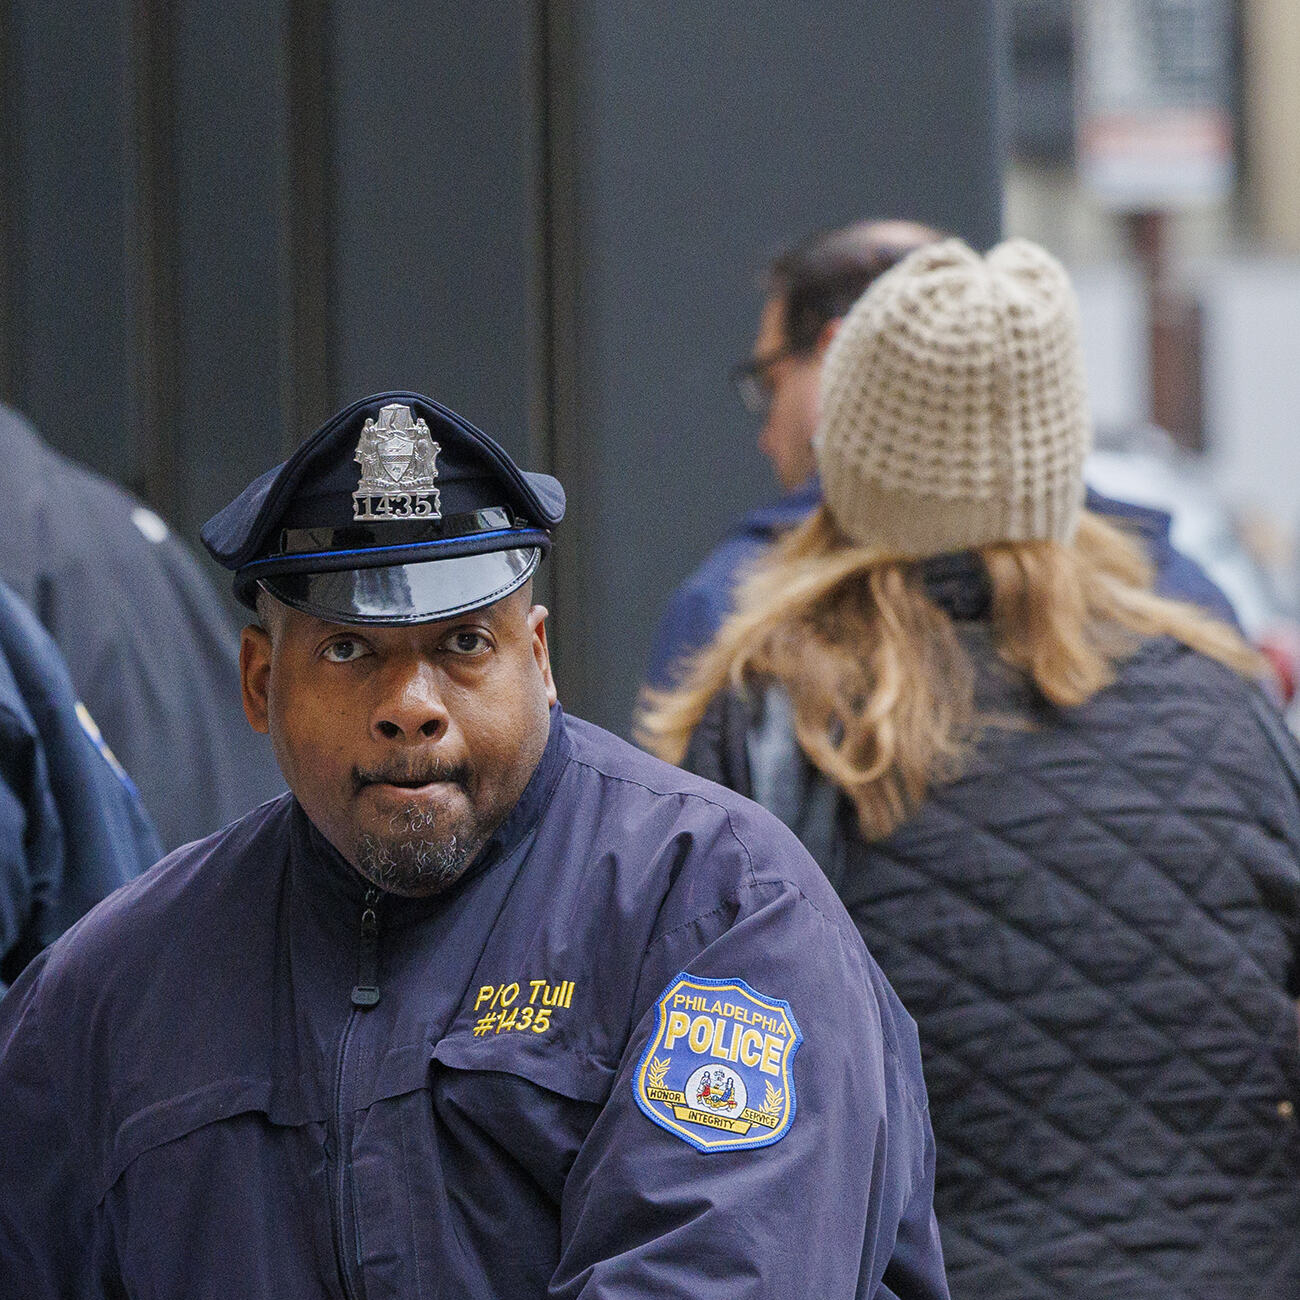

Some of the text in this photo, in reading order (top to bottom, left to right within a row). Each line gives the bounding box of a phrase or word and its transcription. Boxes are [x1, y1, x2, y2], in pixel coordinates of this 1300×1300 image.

[362, 492, 432, 518] 1435
[473, 979, 576, 1011] P/O Tull
[473, 1006, 553, 1037] #1435
[672, 993, 788, 1038] PHILADELPHIA
[663, 1010, 786, 1078] POLICE
[649, 1088, 777, 1129] HONOR INTEGRITY SERVICE
